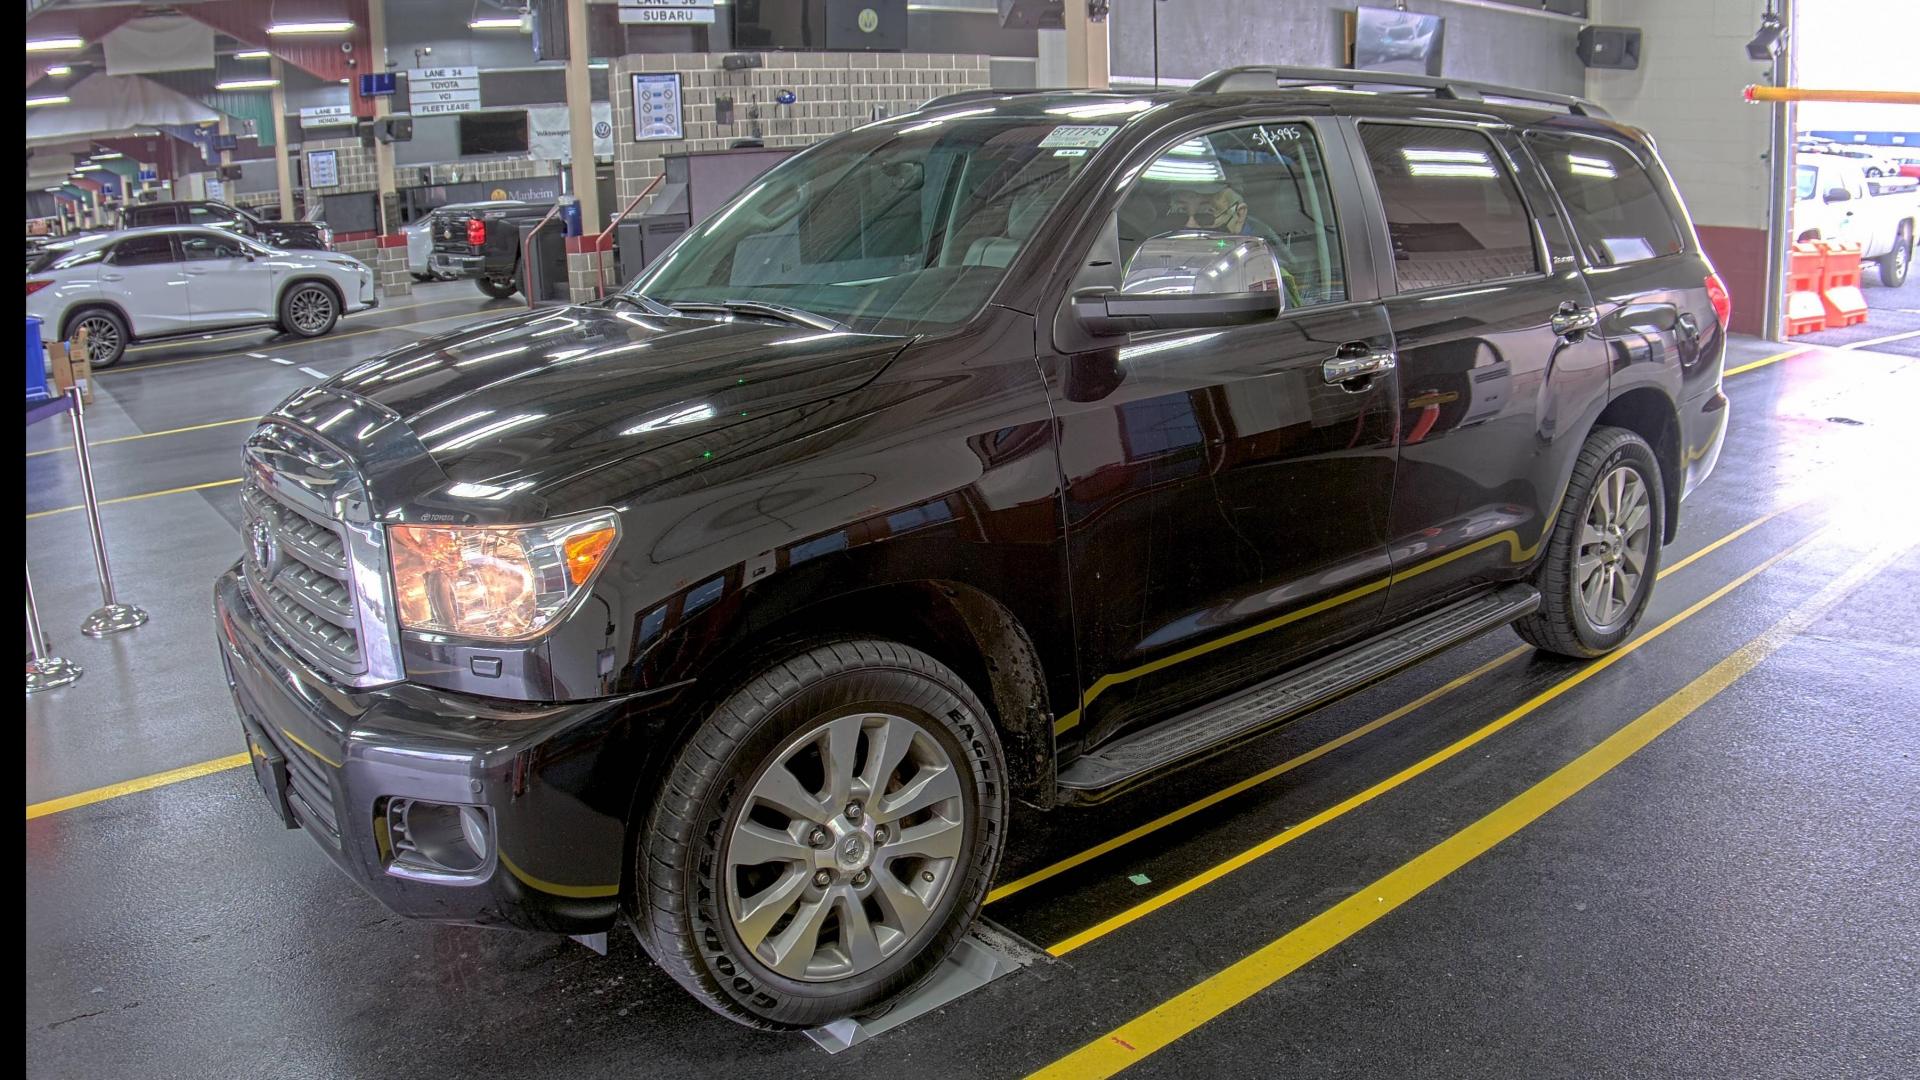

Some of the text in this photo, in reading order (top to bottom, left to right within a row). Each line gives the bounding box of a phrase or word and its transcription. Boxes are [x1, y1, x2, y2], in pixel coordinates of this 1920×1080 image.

[643, 10, 694, 21] SUBARU
[424, 69, 446, 78] LANE
[431, 80, 459, 89] TOYOTA
[439, 92, 451, 100] VCI
[422, 102, 471, 113] FLEET LEASE
[508, 187, 553, 200] Manheim
[947, 708, 997, 801] EAGLE
